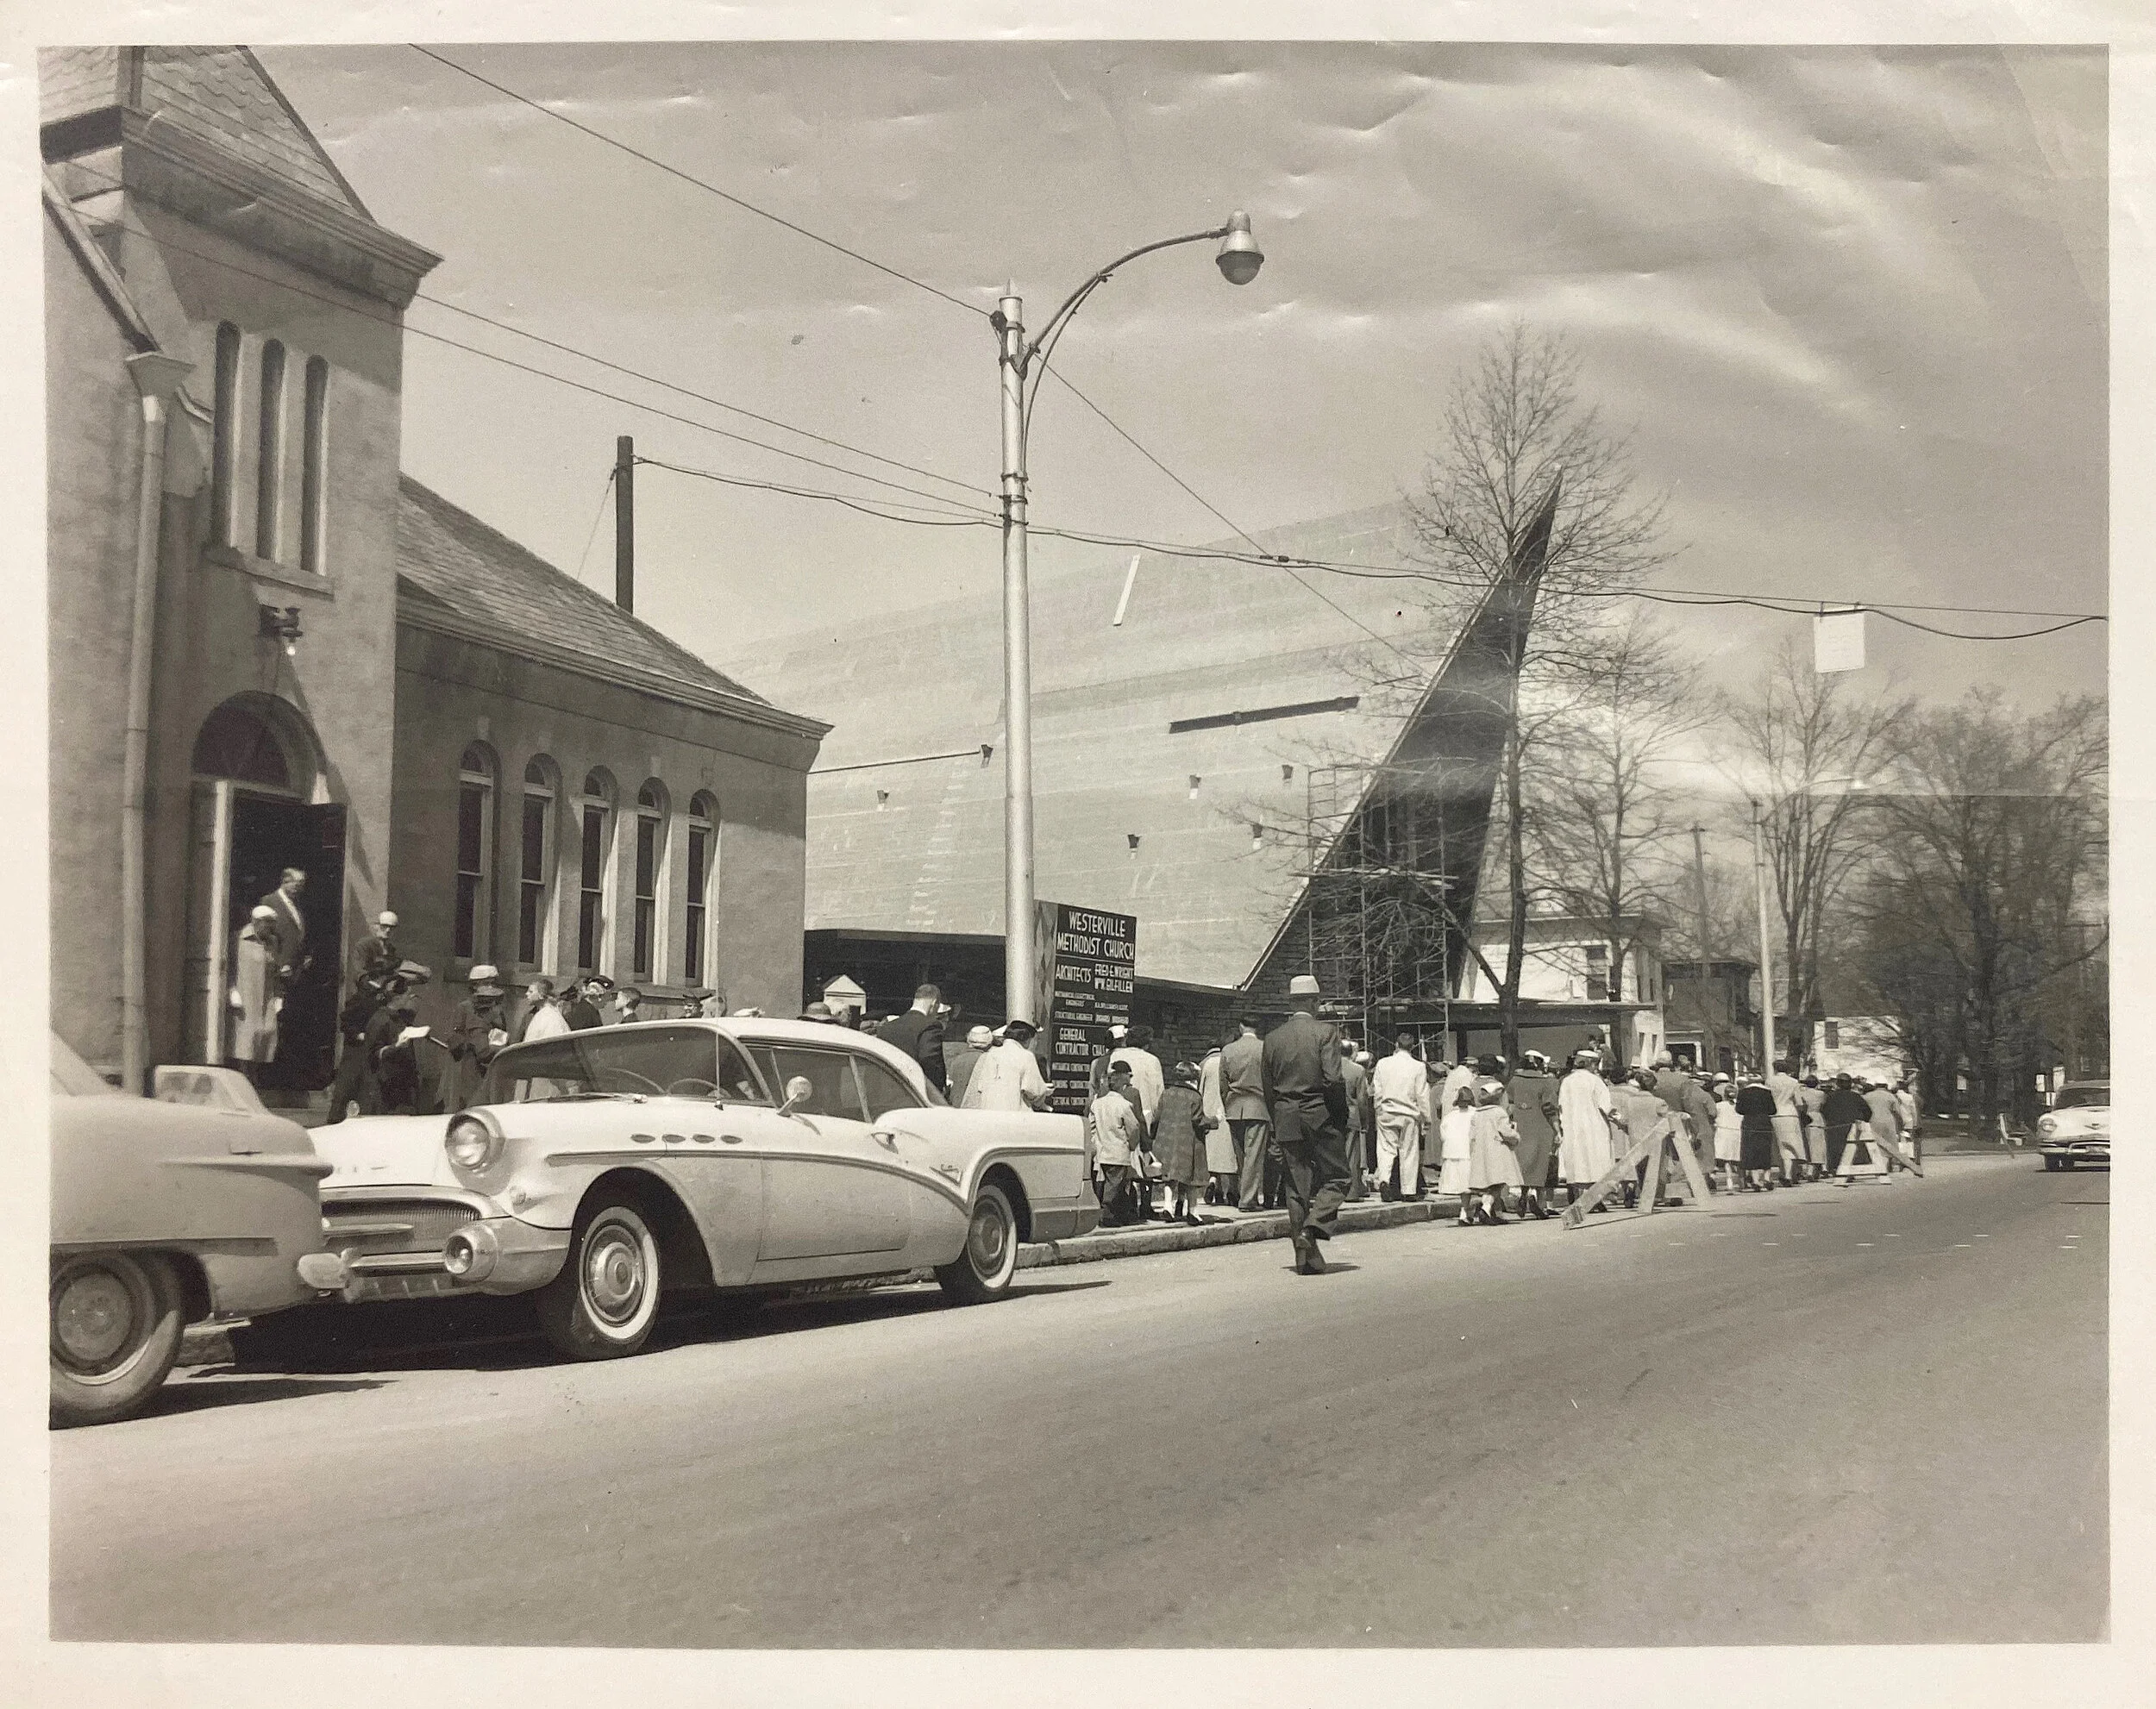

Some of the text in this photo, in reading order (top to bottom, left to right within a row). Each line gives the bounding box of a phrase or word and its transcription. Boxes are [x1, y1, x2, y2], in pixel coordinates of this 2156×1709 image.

[1069, 911, 1125, 937] WESTERVILLE
[1056, 932, 1134, 960] METHODIST CHURCH
[1056, 964, 1091, 983] ARCHITECTS
[1094, 963, 1109, 976] FRED
[1114, 966, 1134, 980] WRIGHT
[1059, 1027, 1086, 1041] GENERAL
[1056, 1042, 1089, 1055] CONTRACTOR
